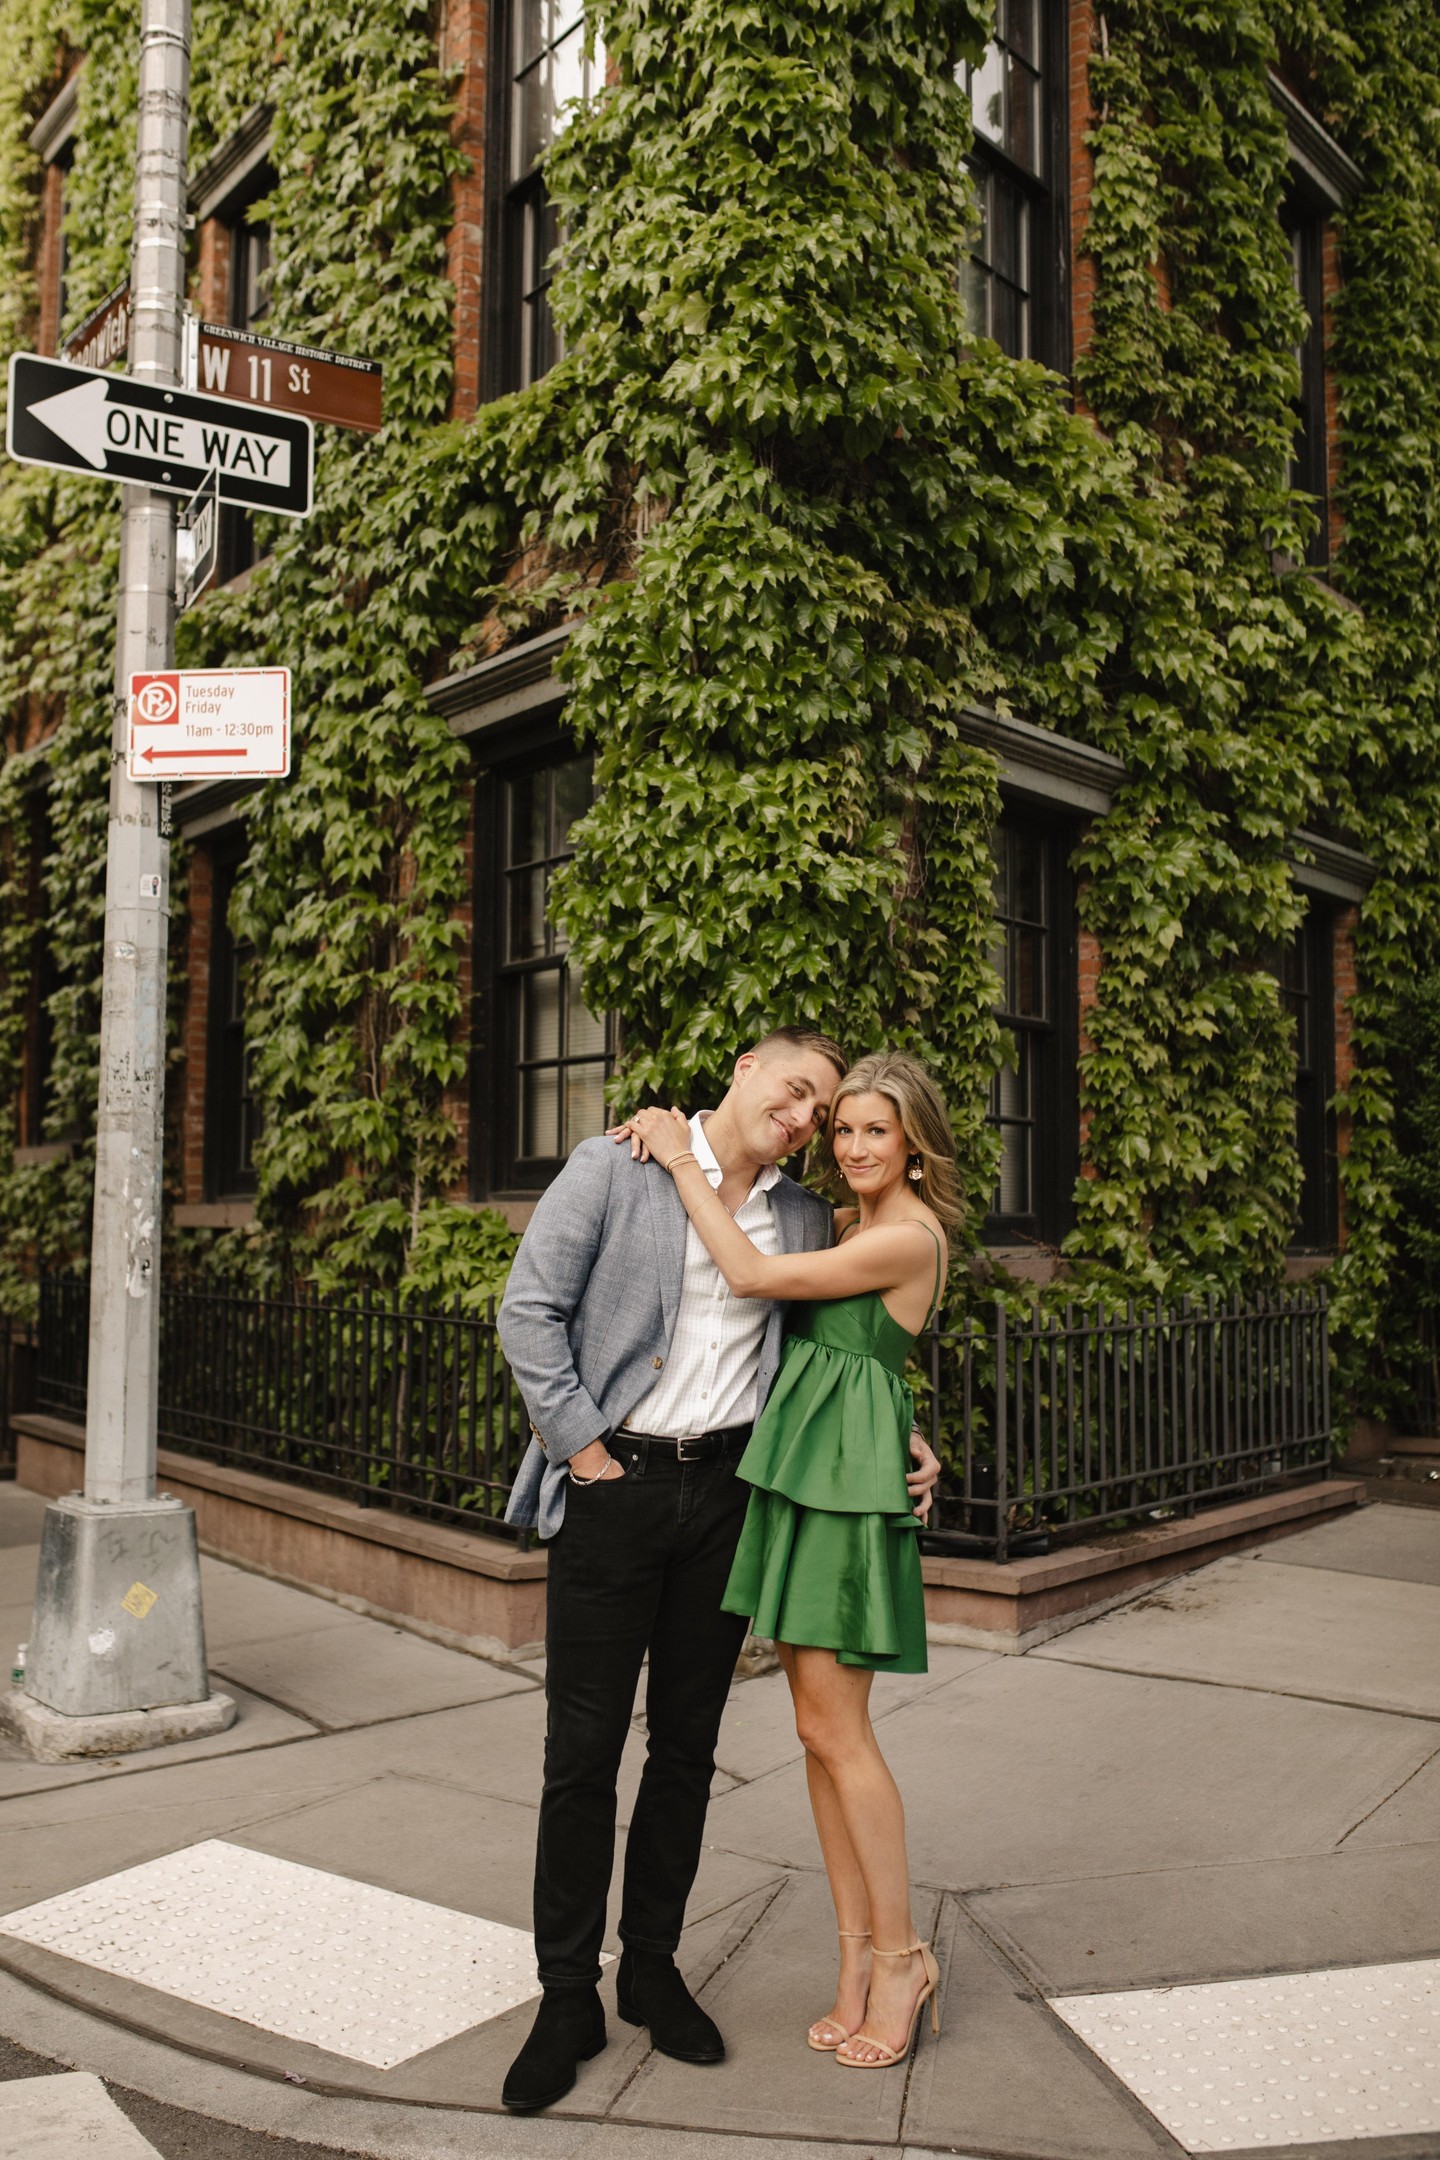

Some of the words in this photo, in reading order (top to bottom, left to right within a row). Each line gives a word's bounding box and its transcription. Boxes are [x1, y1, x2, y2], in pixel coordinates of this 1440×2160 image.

[203, 324, 255, 345] GREENWICH
[257, 336, 294, 354] VILLAGE
[295, 346, 333, 363] HISTORIC
[334, 355, 373, 371] DISTRICT
[202, 343, 231, 392] W
[248, 355, 272, 402] 11
[287, 363, 311, 395] St
[106, 409, 185, 459] ONE
[202, 428, 280, 477] WAY
[185, 685, 235, 699] Tuesday
[185, 702, 221, 715] Friday
[185, 725, 213, 737] 11am
[224, 723, 273, 738] 12:30pm
